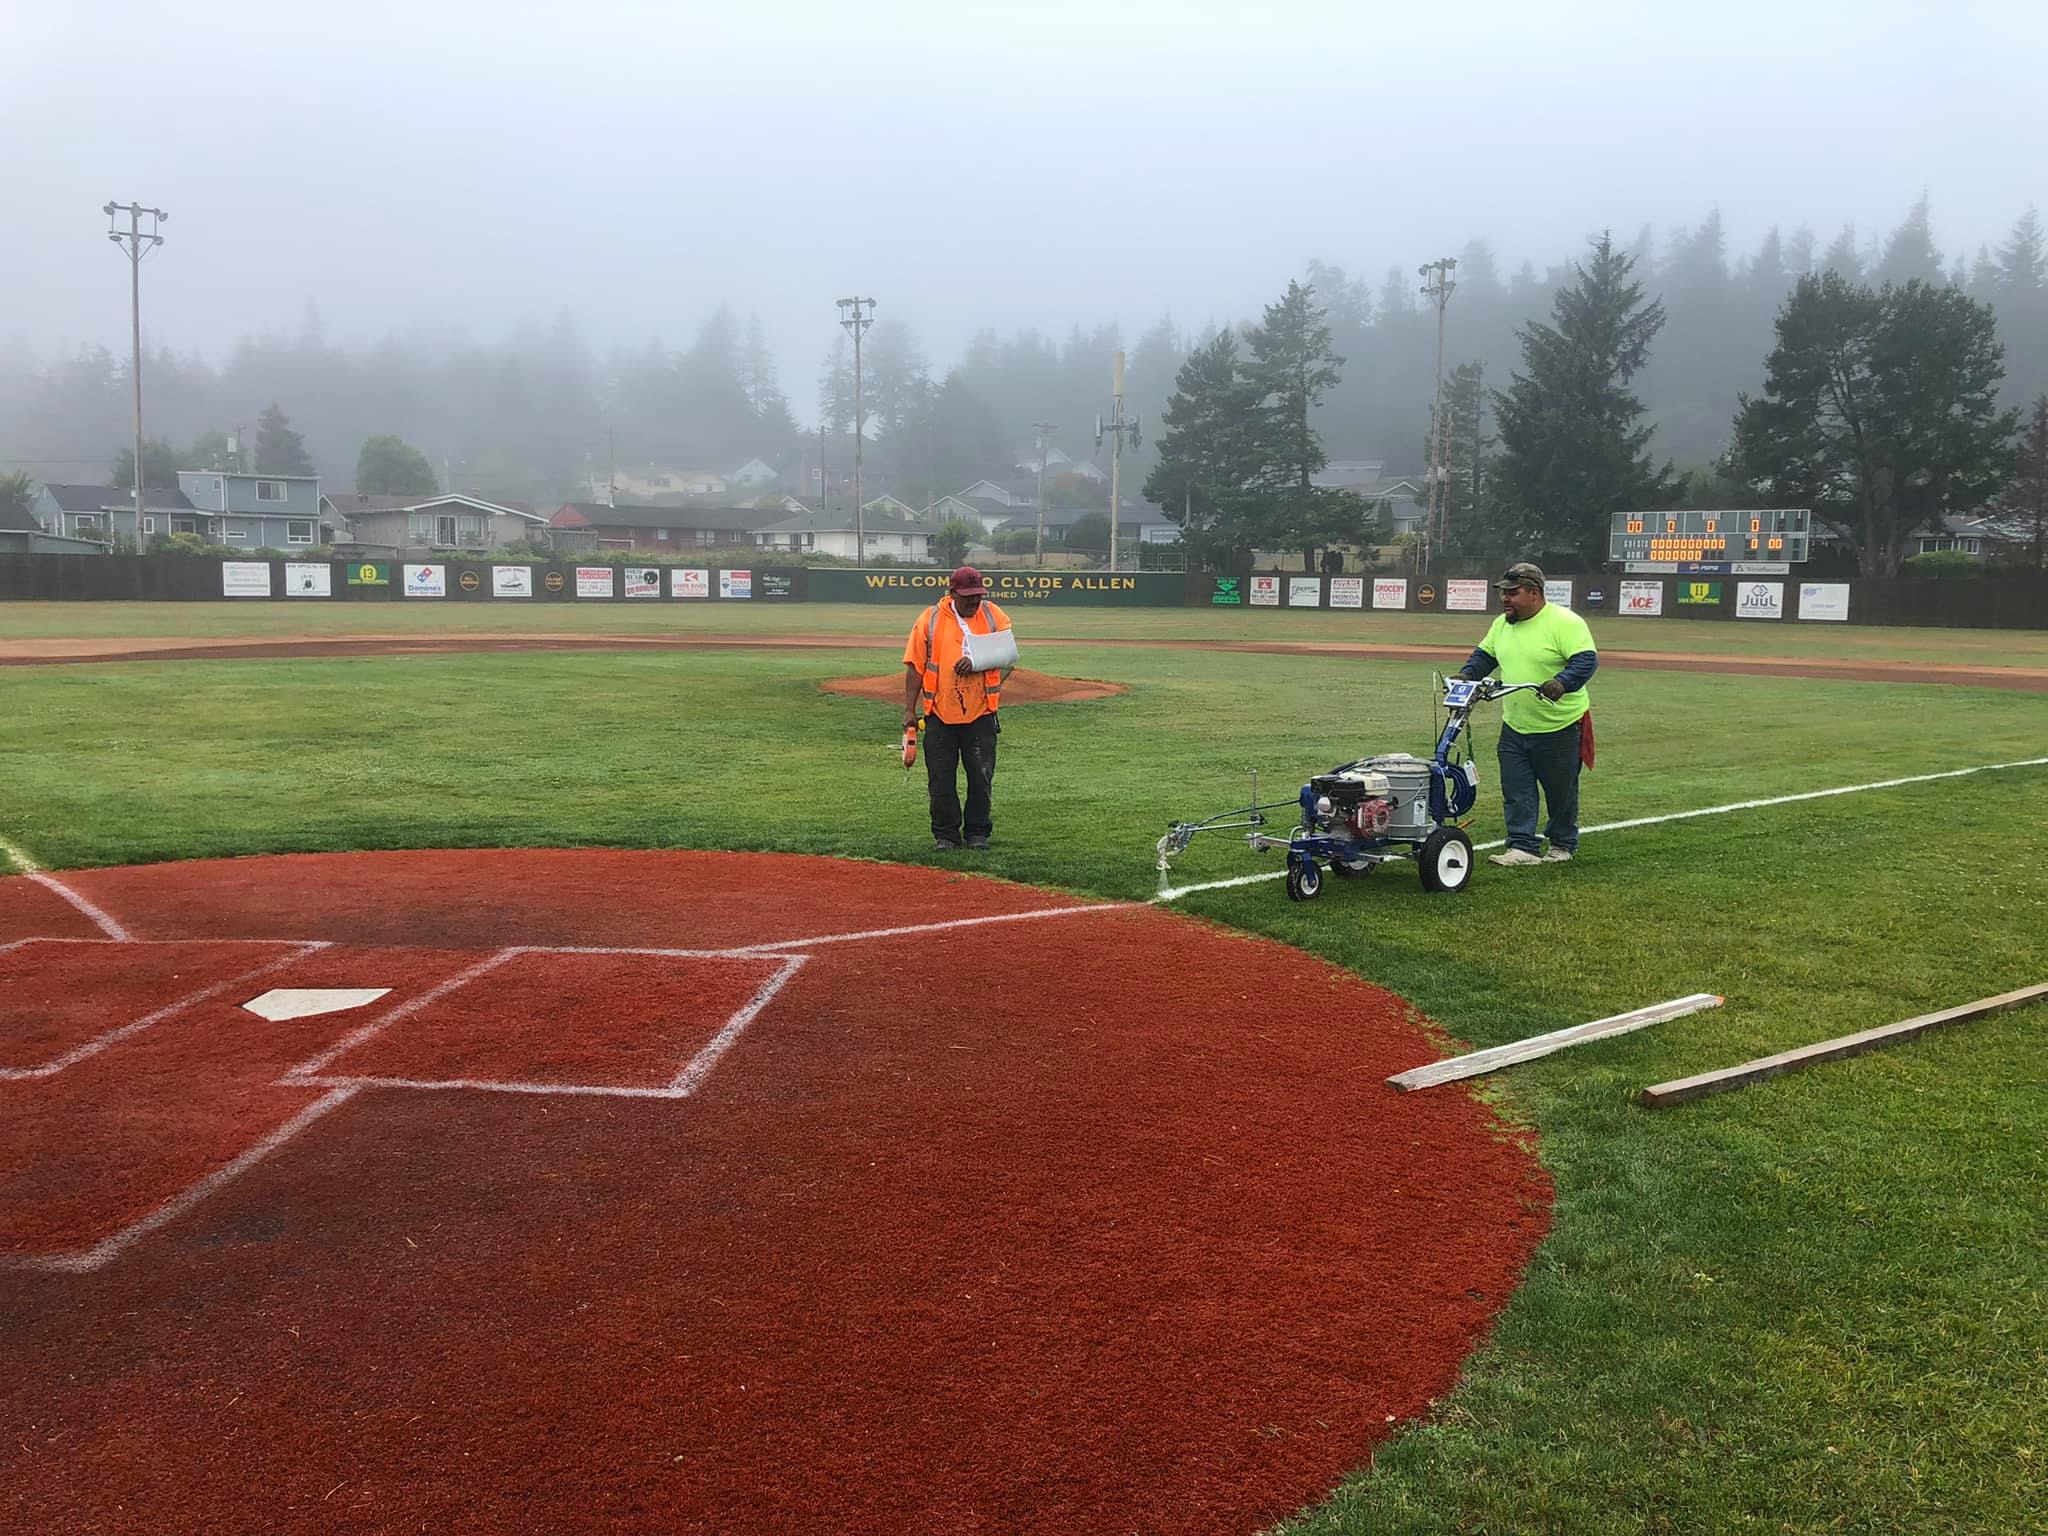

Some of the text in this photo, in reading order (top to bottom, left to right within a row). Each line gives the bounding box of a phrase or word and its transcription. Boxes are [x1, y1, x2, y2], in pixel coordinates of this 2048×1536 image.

[363, 568, 374, 579] 13
[865, 575, 950, 588] WELCOM
[1000, 577, 1063, 589] CLYDE
[1071, 577, 1135, 589] ALLEN
[1375, 585, 1405, 593] GROCERY
[1023, 590, 1050, 599] 1947
[1379, 592, 1401, 600] OUTLET
[1627, 596, 1654, 608] ACE
